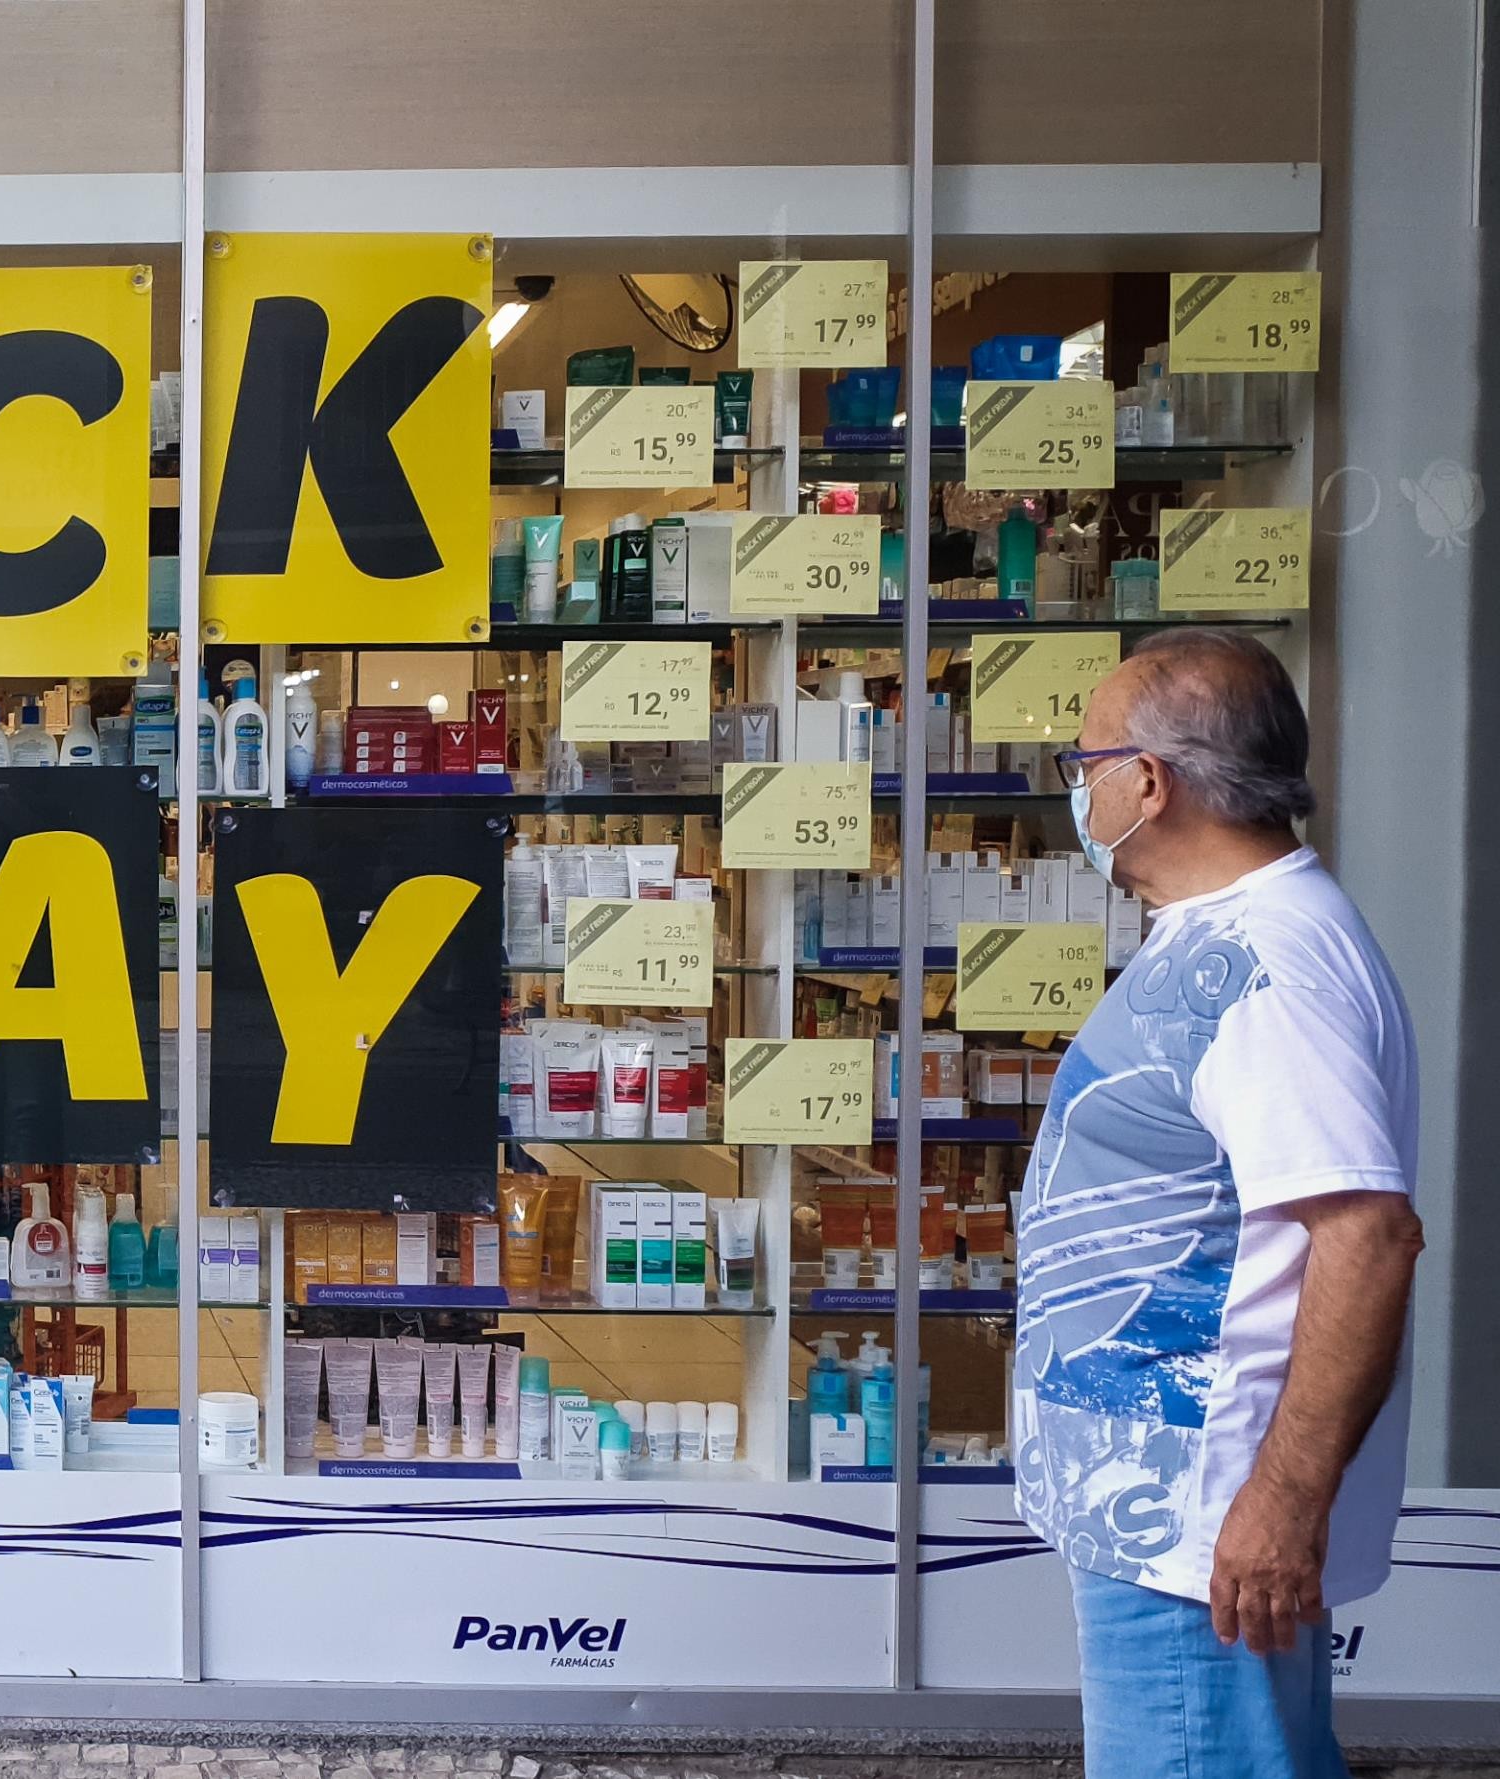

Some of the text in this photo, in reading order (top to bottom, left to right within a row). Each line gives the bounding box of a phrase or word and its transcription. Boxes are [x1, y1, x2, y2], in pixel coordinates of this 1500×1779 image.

[477, 697, 505, 705] VICHY
[137, 701, 172, 713] Cetaphil
[321, 779, 408, 790] dermocosméticos
[553, 1041, 579, 1049] DERCOS
[567, 1416, 594, 1424] VICHY
[331, 1466, 416, 1477] dermocosméticos
[453, 1616, 627, 1653] PanVel
[550, 1656, 615, 1668] FARMÁCIAS
